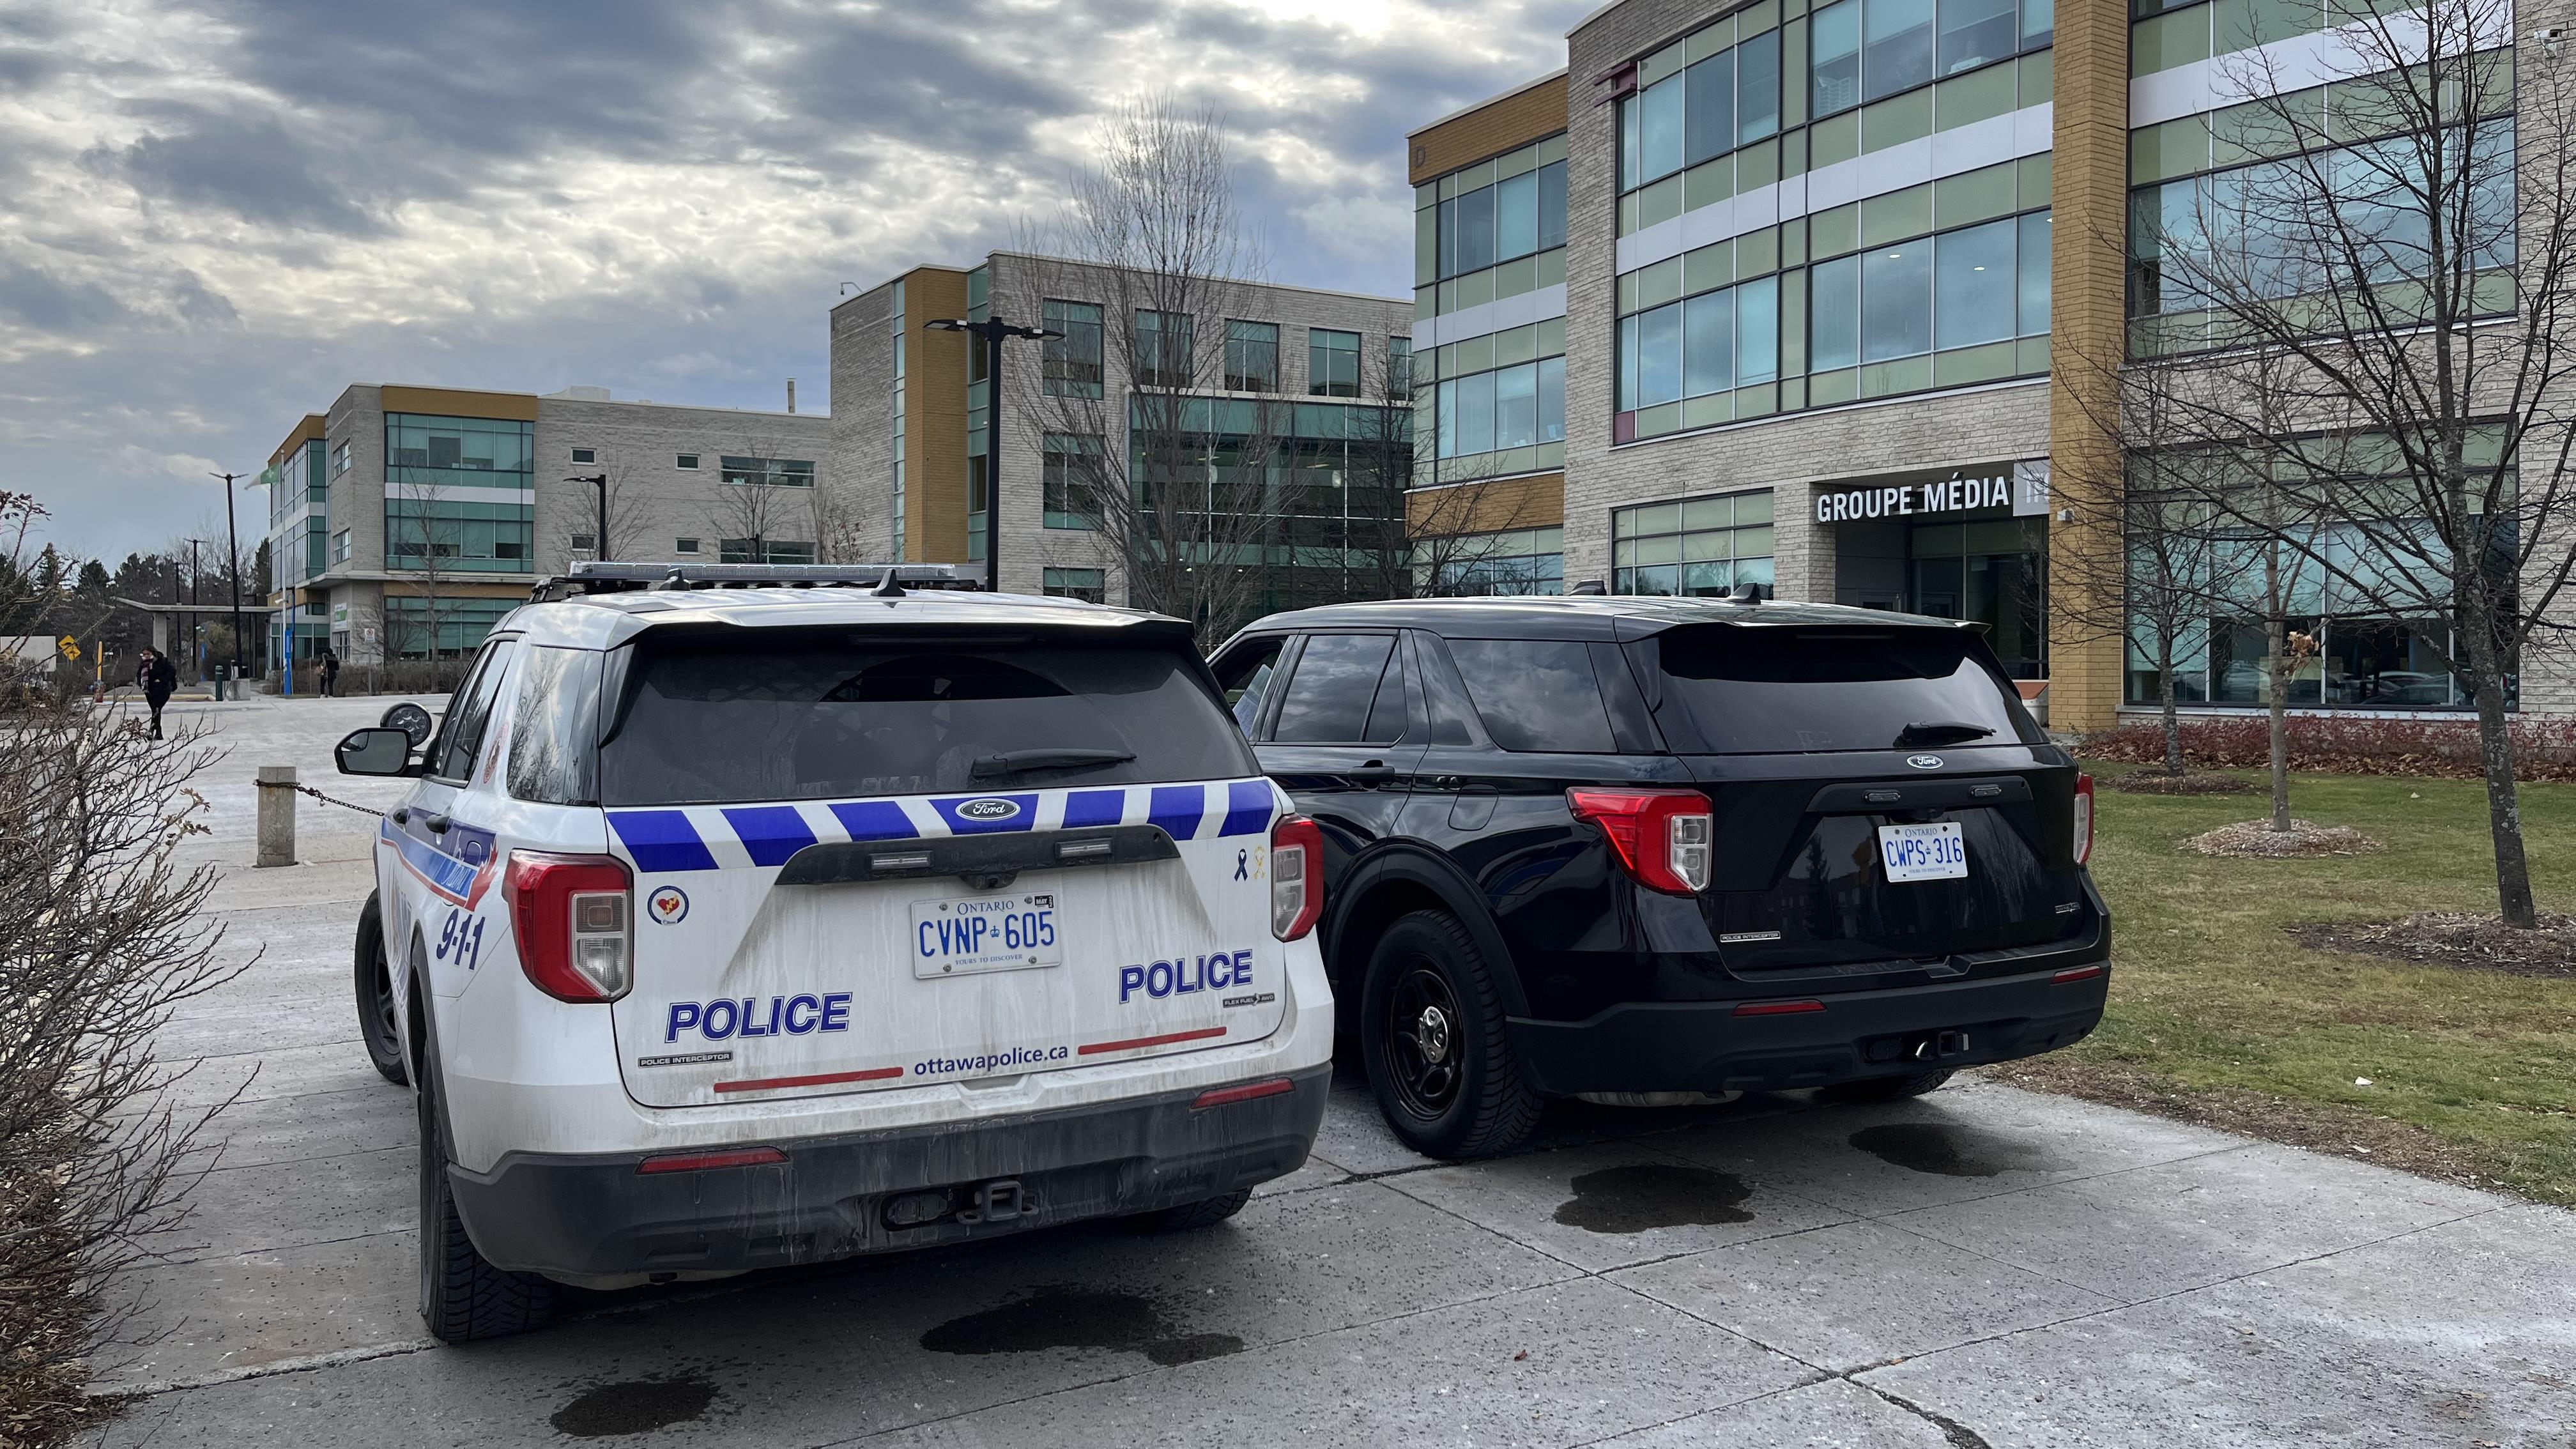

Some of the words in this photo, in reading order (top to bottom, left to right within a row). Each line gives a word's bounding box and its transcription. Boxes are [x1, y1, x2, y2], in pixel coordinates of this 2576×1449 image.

[1818, 486, 1912, 522] GROUPE
[1924, 471, 2009, 512] MÉDIA
[972, 802, 1005, 815] Ford
[1905, 828, 1938, 838] ONTARIO
[1886, 839, 1926, 866] CWPS
[1933, 837, 1962, 863] 316
[957, 900, 1014, 915] ONTARIO
[436, 908, 486, 970] 9-1-1
[919, 916, 987, 957] CVNP
[1005, 910, 1054, 949] 605
[990, 954, 1022, 962] DISCOVER
[1119, 949, 1252, 1004] POLICE
[664, 992, 852, 1043] POLICE
[673, 1054, 730, 1063] INTERCEPTOR
[914, 1046, 1068, 1075] ottawapolice.ca
